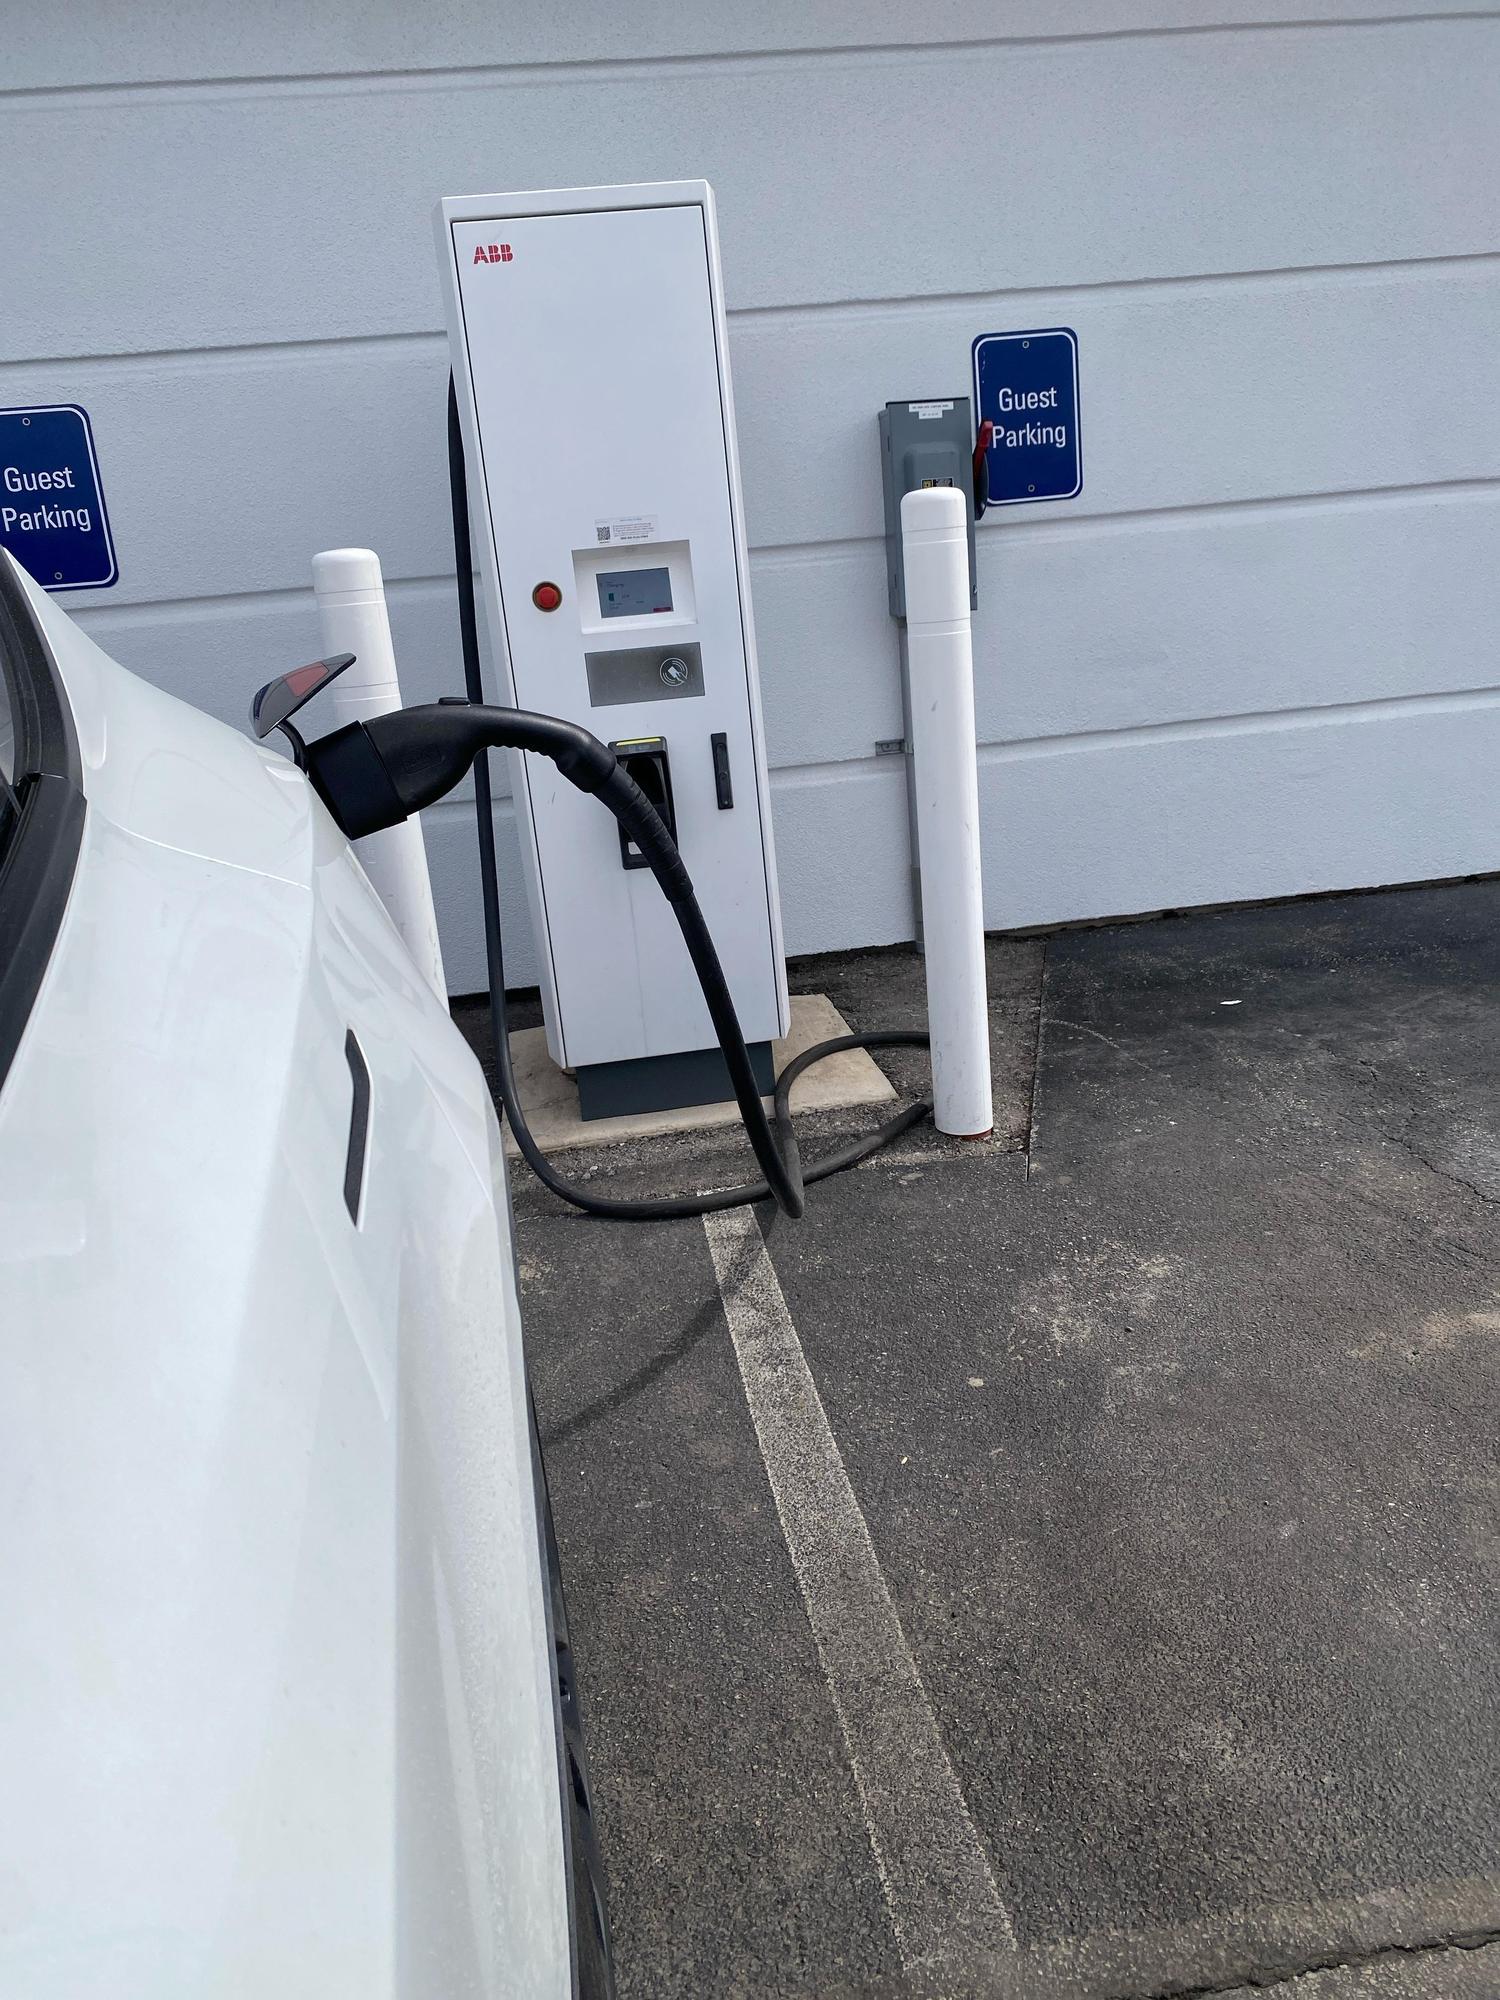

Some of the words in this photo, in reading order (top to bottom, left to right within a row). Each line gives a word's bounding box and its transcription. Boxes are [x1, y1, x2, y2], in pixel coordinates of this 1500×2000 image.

[473, 244, 514, 265] ABB
[998, 386, 1058, 412] Guest
[992, 421, 1067, 449] Parking
[3, 466, 76, 493] Guest
[1, 504, 92, 532] Parking
